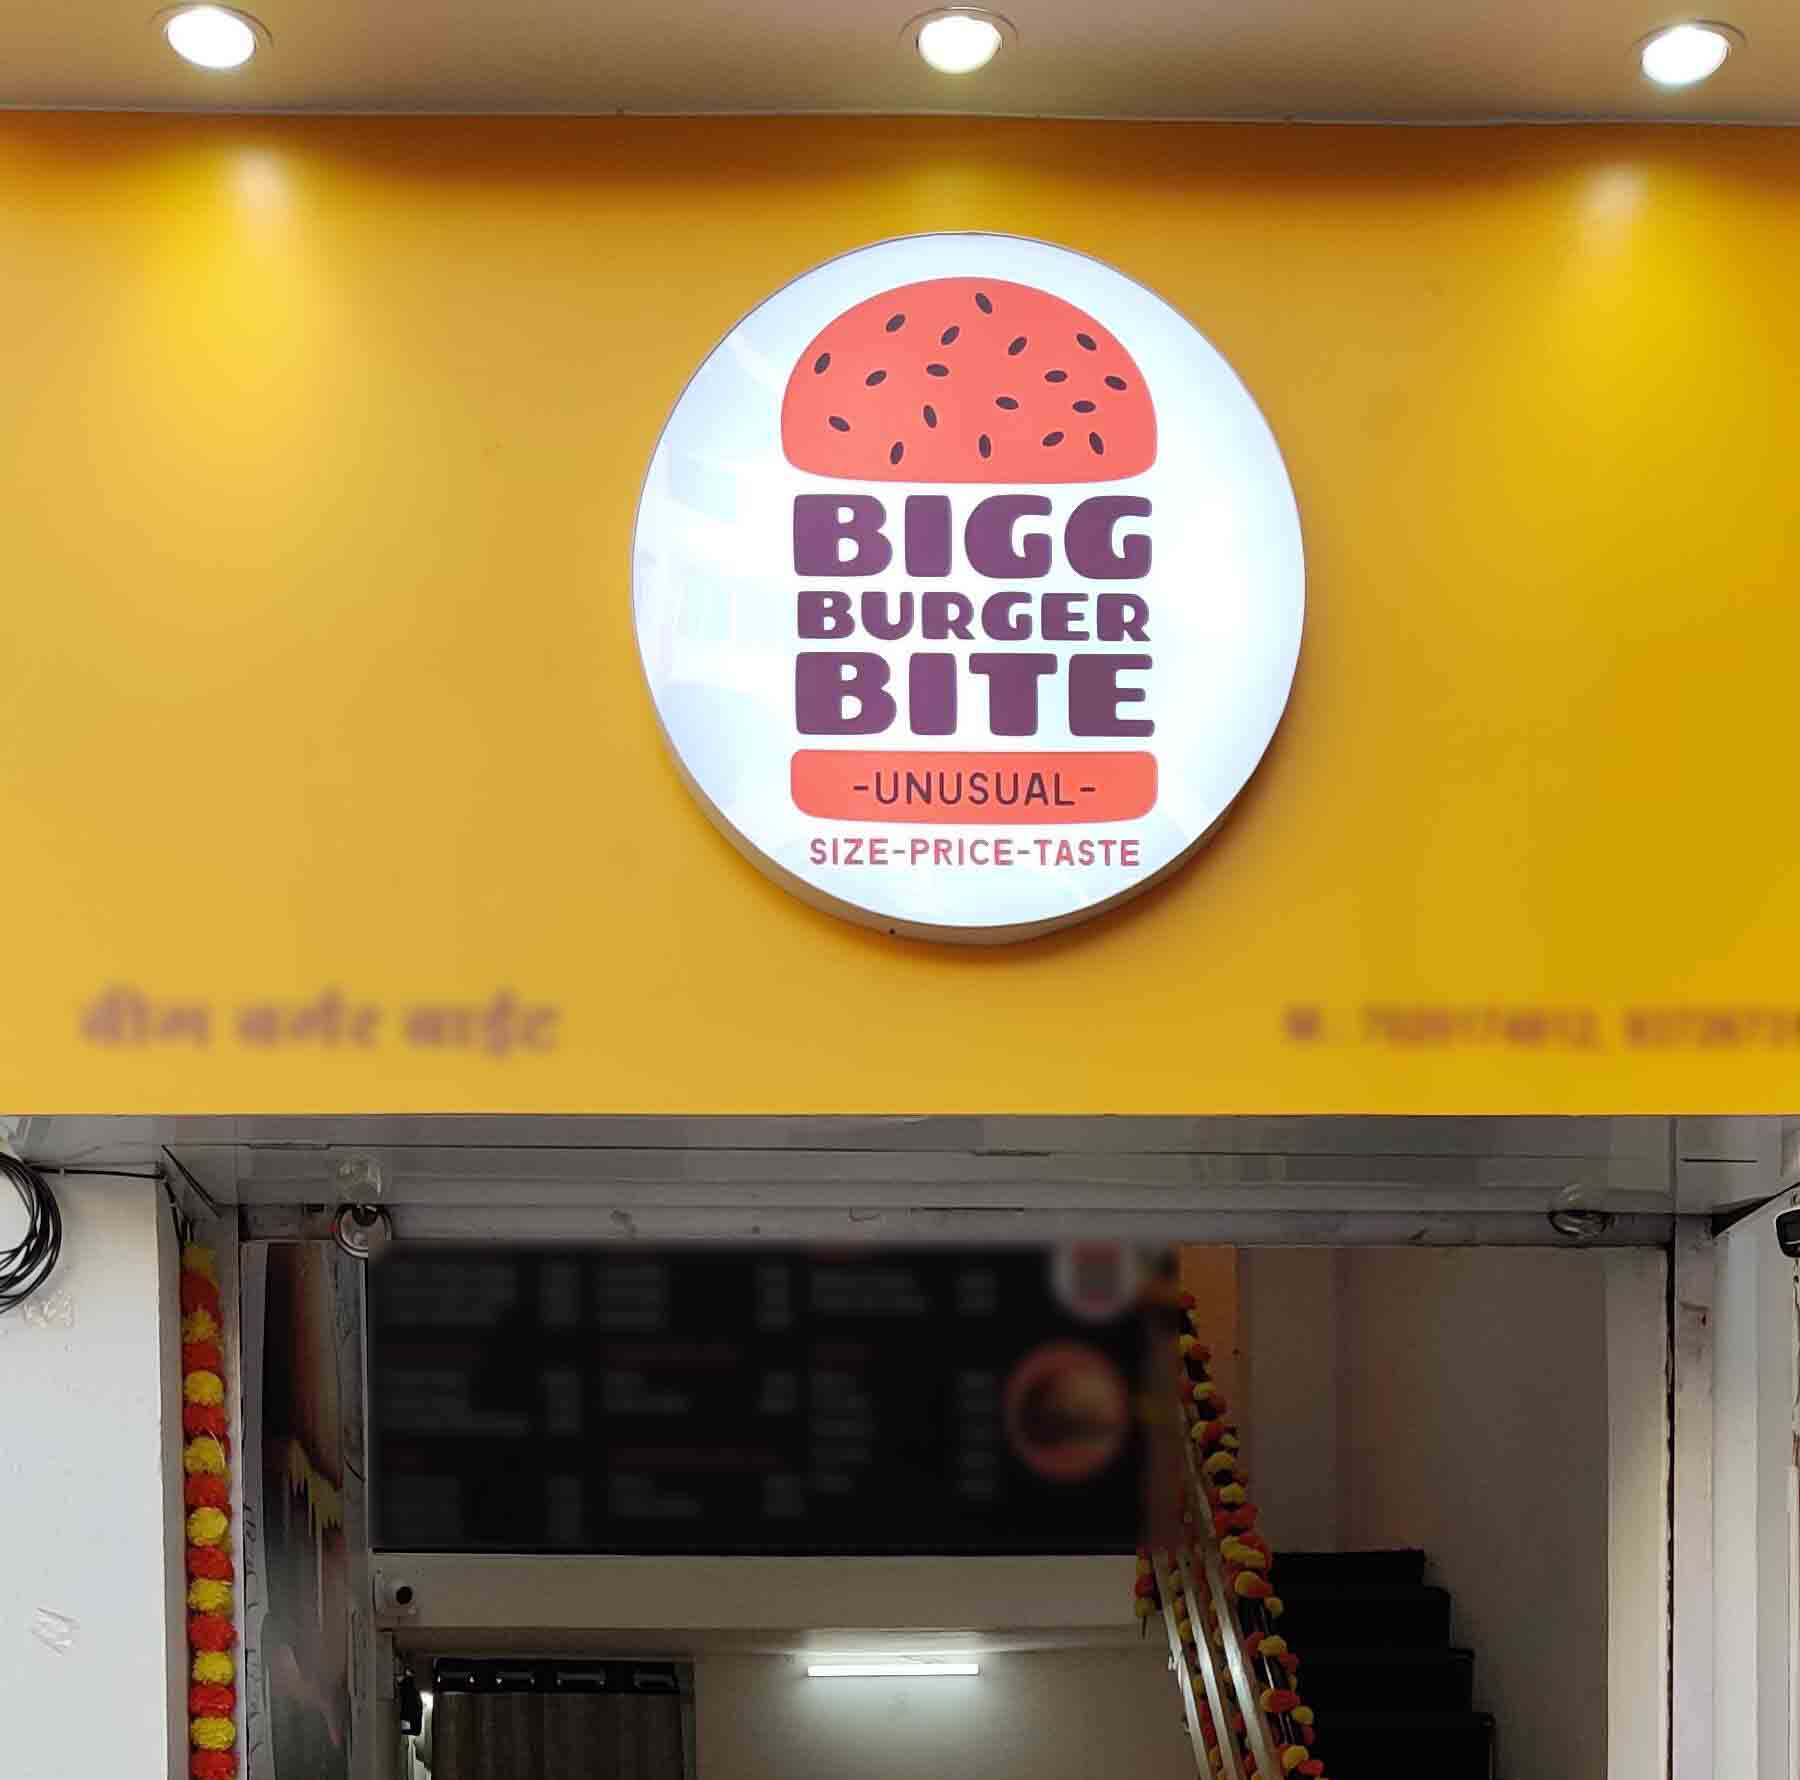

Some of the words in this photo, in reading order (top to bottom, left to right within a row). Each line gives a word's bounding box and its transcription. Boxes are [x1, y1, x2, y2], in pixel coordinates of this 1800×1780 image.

[793, 494, 1153, 579] BIGG
[797, 590, 1151, 642] BURGER
[794, 651, 1155, 737] BITE
